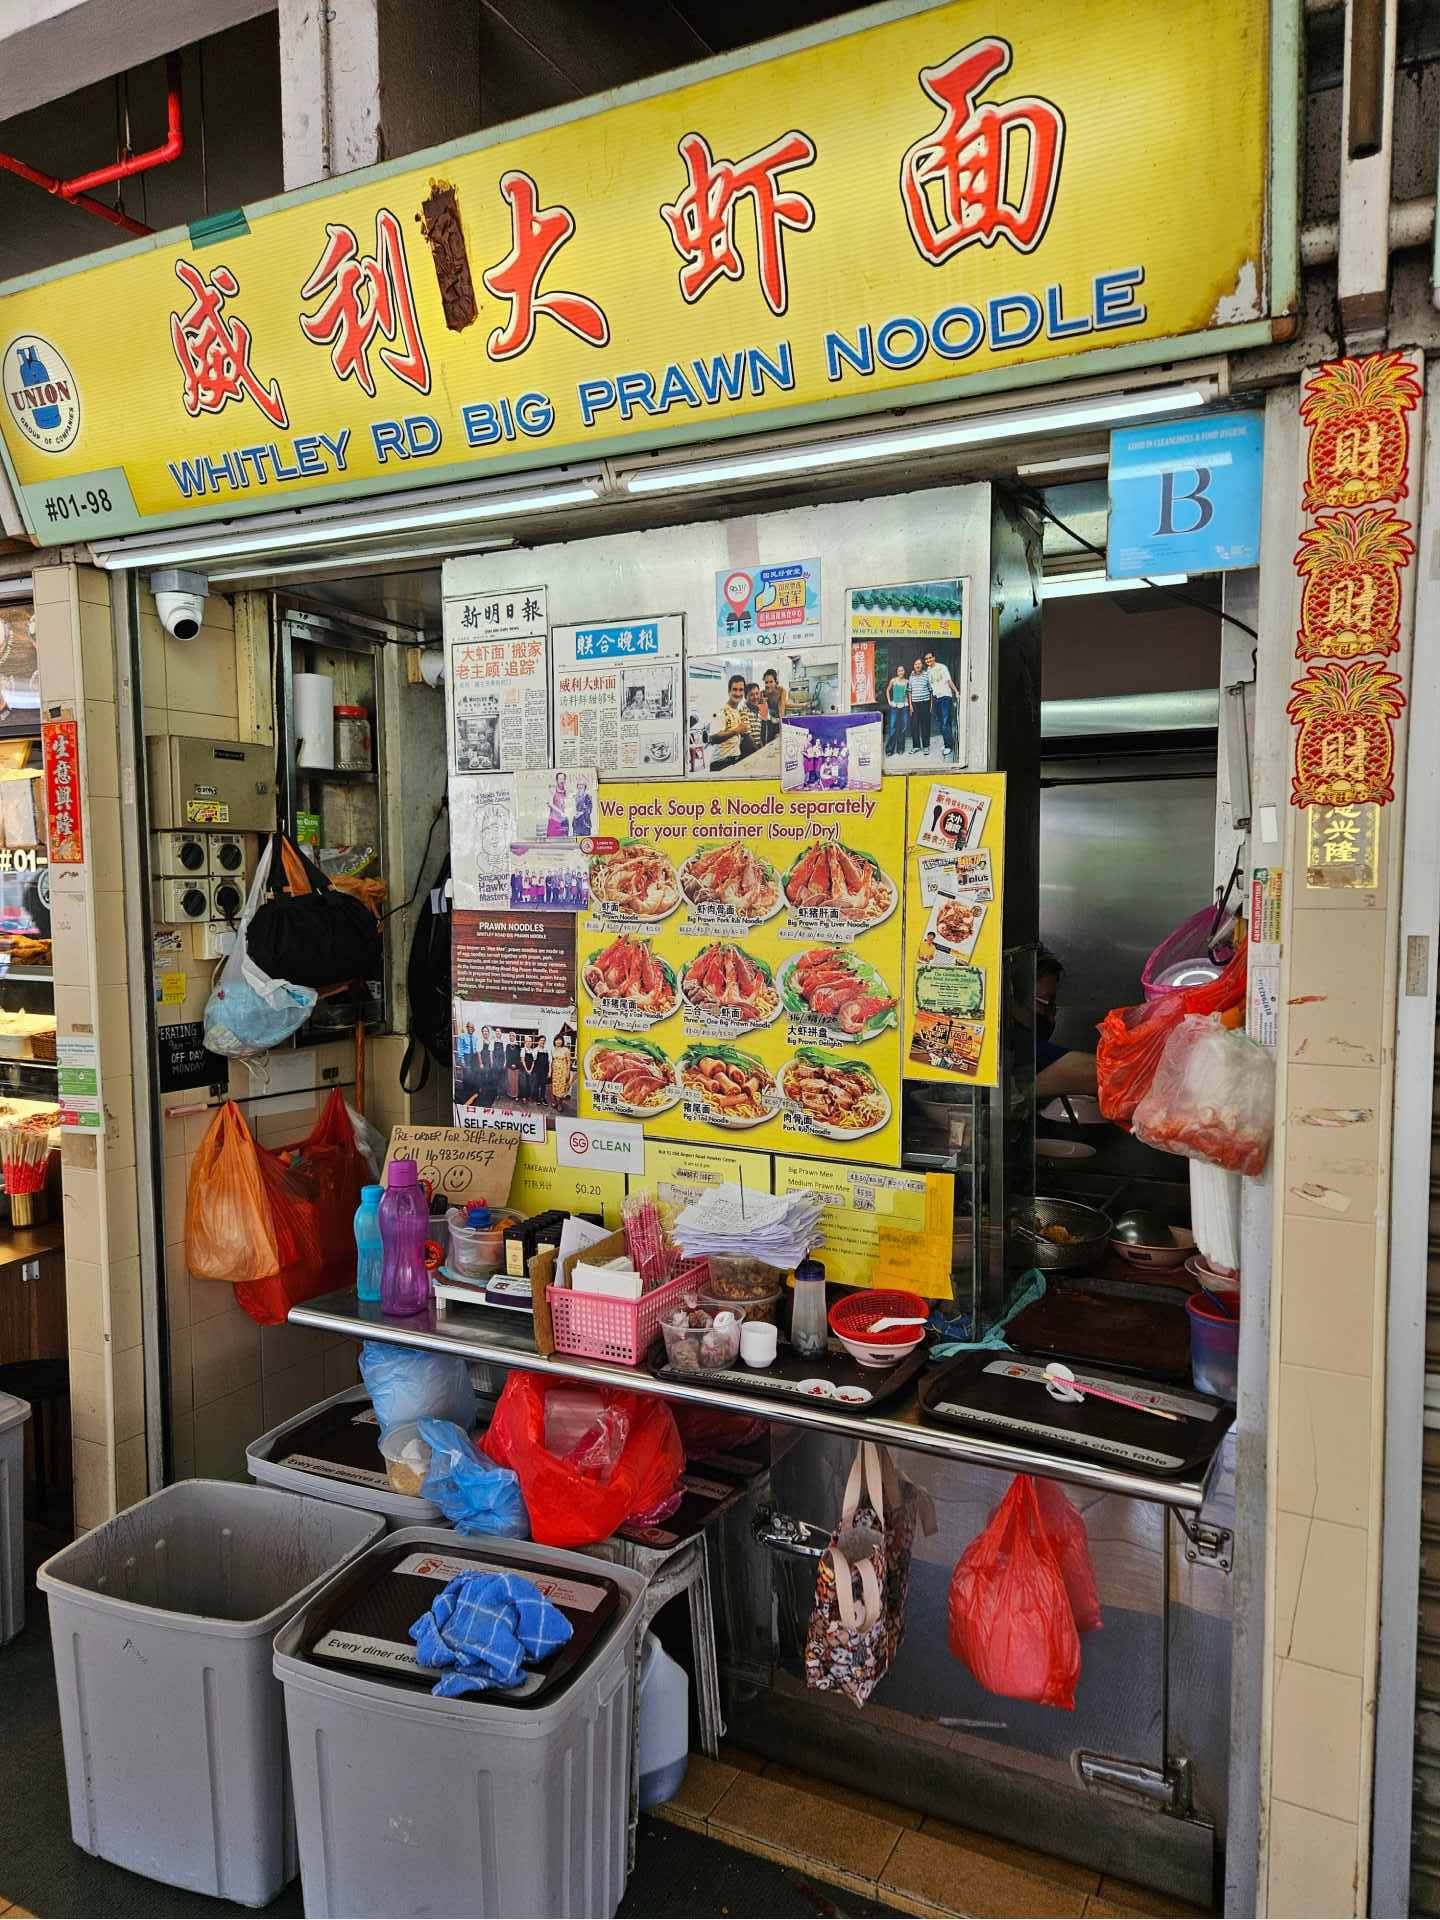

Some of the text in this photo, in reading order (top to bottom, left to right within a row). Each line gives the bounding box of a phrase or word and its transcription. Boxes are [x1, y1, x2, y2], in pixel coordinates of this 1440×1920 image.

[169, 266, 1147, 497] WHITLEY RD BIG PRAWN NOODLE
[11, 380, 71, 412] UNION
[45, 488, 113, 522] #01-98
[1151, 466, 1214, 537] B
[461, 597, 544, 630] 新明日報
[600, 795, 876, 820] We pack Soup & Noodle separately
[629, 821, 840, 841] for your container (Soup/Dry)
[602, 902, 619, 912] 虾面
[698, 905, 735, 915] 虾肉骨面
[798, 908, 839, 919] 虾猪肝面
[479, 921, 545, 932] PRAWN NOODLES
[593, 1009, 601, 1017] Big
[721, 1007, 741, 1018] 虾面
[719, 1019, 728, 1027] Big
[159, 1023, 198, 1041] ERATING
[788, 1025, 828, 1037] 大虾拼盘
[788, 1038, 796, 1046] Big
[818, 1040, 843, 1048] Delights
[171, 1050, 205, 1064] OFF DAY
[172, 1060, 206, 1076] MONDAY
[615, 1106, 634, 1114] Noodle
[683, 1114, 697, 1122] Pig's
[709, 1116, 729, 1124] Noodle
[783, 1113, 813, 1125] 肉骨面
[464, 1118, 536, 1135] SELF-SERVICE
[810, 1127, 832, 1135] Noodle
[394, 1127, 442, 1142] PRE-ORDER
[443, 1131, 460, 1142] FOR
[571, 1137, 632, 1153] SG CLEAN
[393, 1146, 420, 1161] Call
[521, 1163, 557, 1174] TAKEAWAY
[788, 1166, 834, 1178] Big Prawn Mee
[575, 1183, 602, 1196] $0.20
[788, 1179, 851, 1193] Medium Prawn Mee
[945, 1407, 982, 1421] Every
[1092, 1442, 1129, 1456] clean
[1132, 1451, 1168, 1467] table
[288, 1458, 311, 1469] Every
[328, 1638, 362, 1655] Every
[362, 1644, 394, 1659] diner
